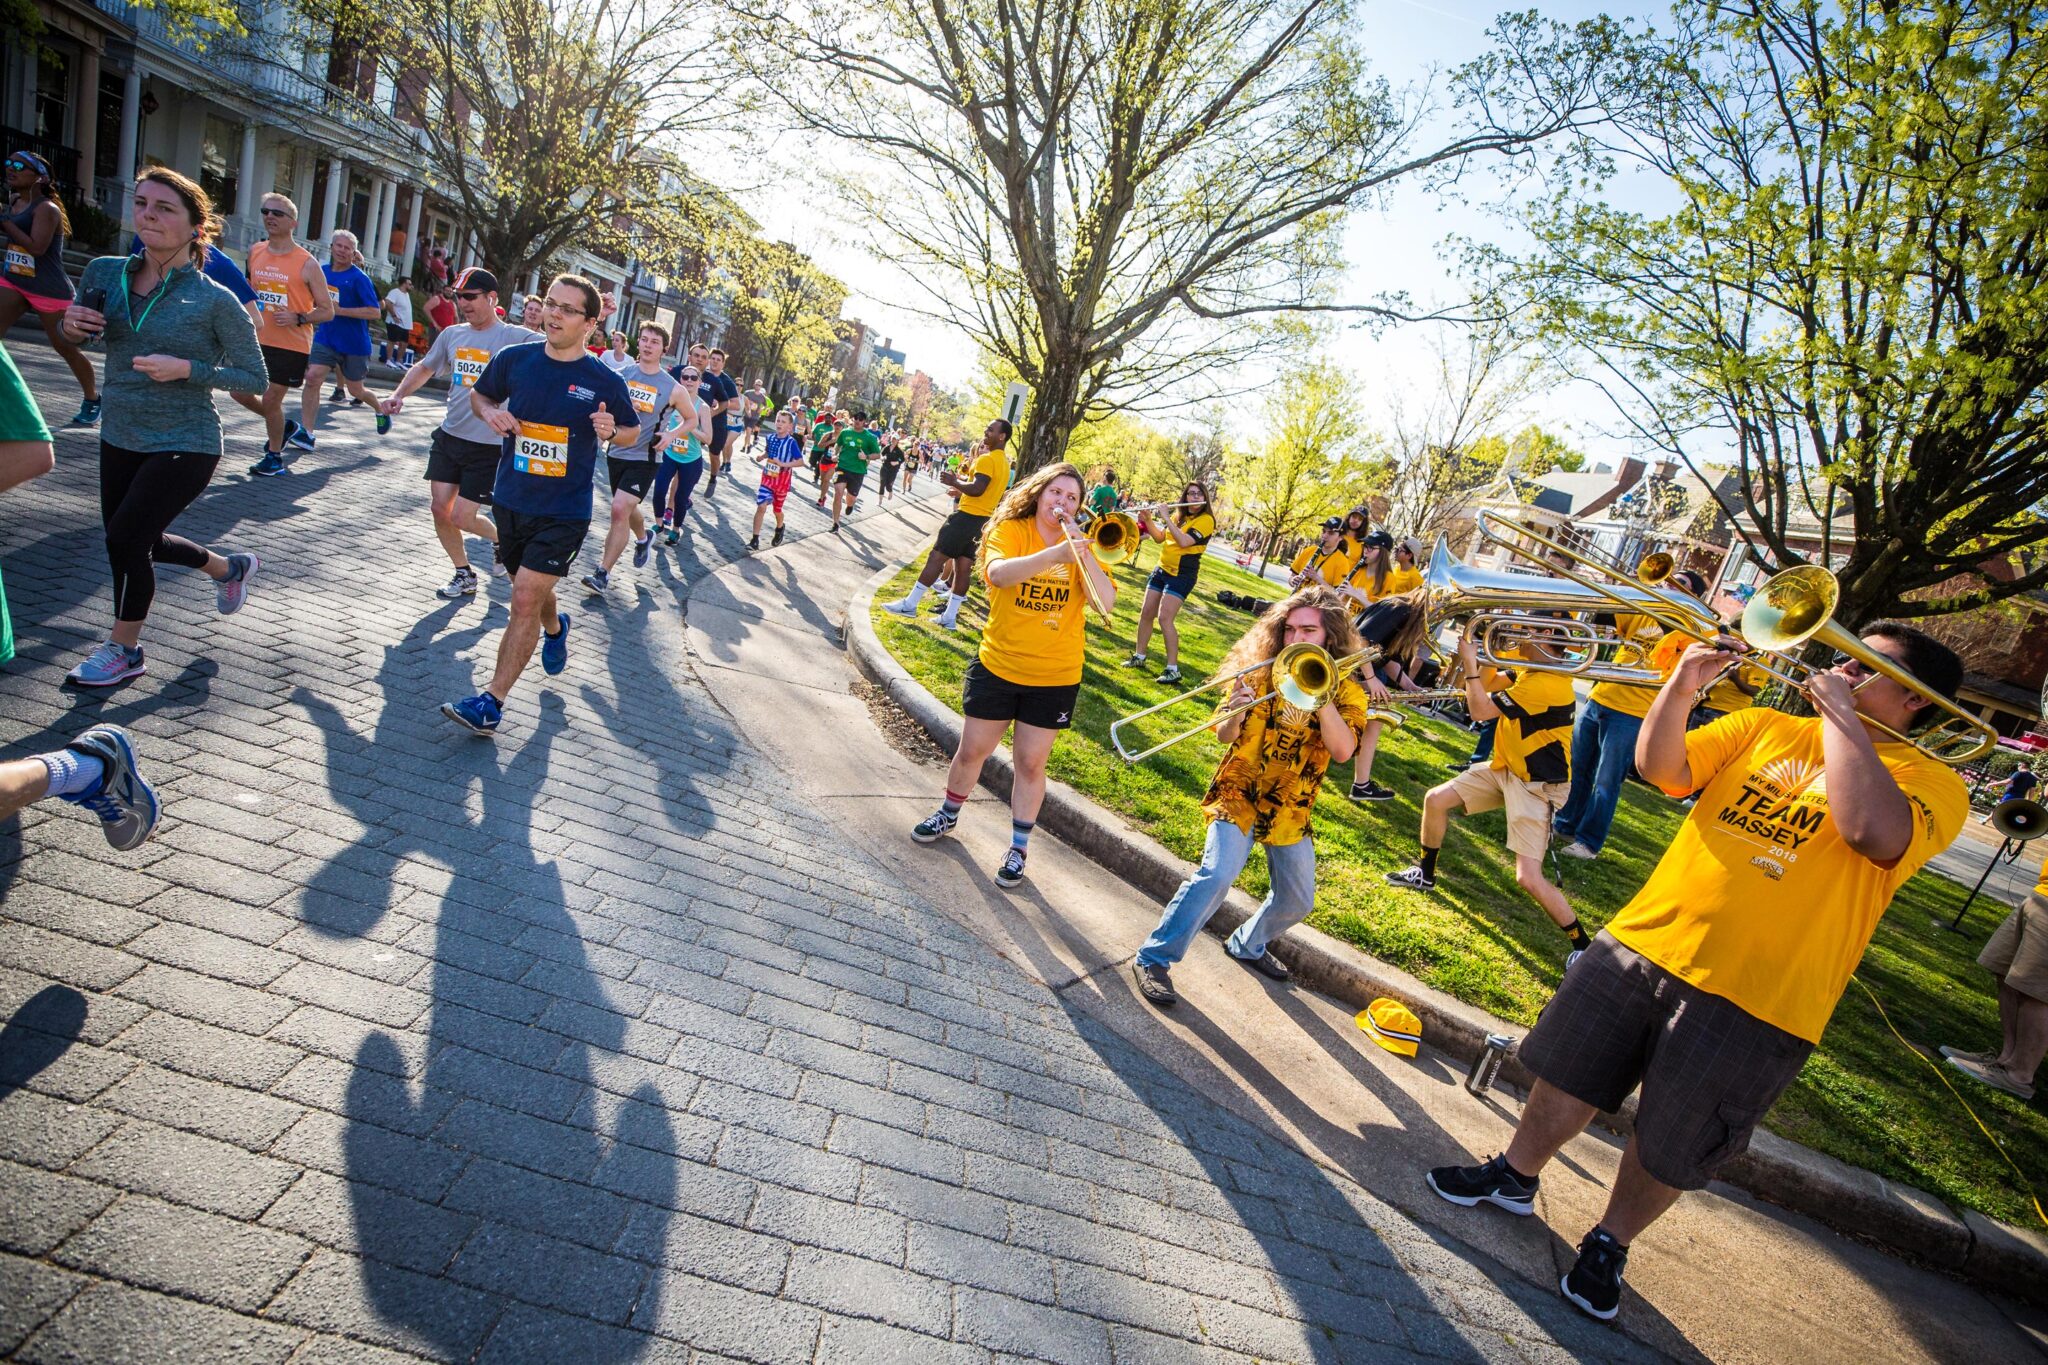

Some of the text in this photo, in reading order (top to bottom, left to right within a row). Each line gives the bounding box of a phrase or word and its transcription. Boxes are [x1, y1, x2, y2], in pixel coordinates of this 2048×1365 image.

[255, 269, 289, 281] MARATHON
[259, 292, 282, 304] 6257
[457, 361, 482, 374] 5024
[629, 388, 652, 402] 6227
[521, 440, 558, 460] 6261
[1020, 582, 1070, 603] TEAM
[1015, 597, 1066, 613] MASSEY
[1748, 774, 1767, 785] MY
[1764, 782, 1792, 799] MILS
[1735, 784, 1826, 834] TEAM
[1718, 806, 1809, 850] MASSEY
[1768, 845, 1798, 863] 2018
